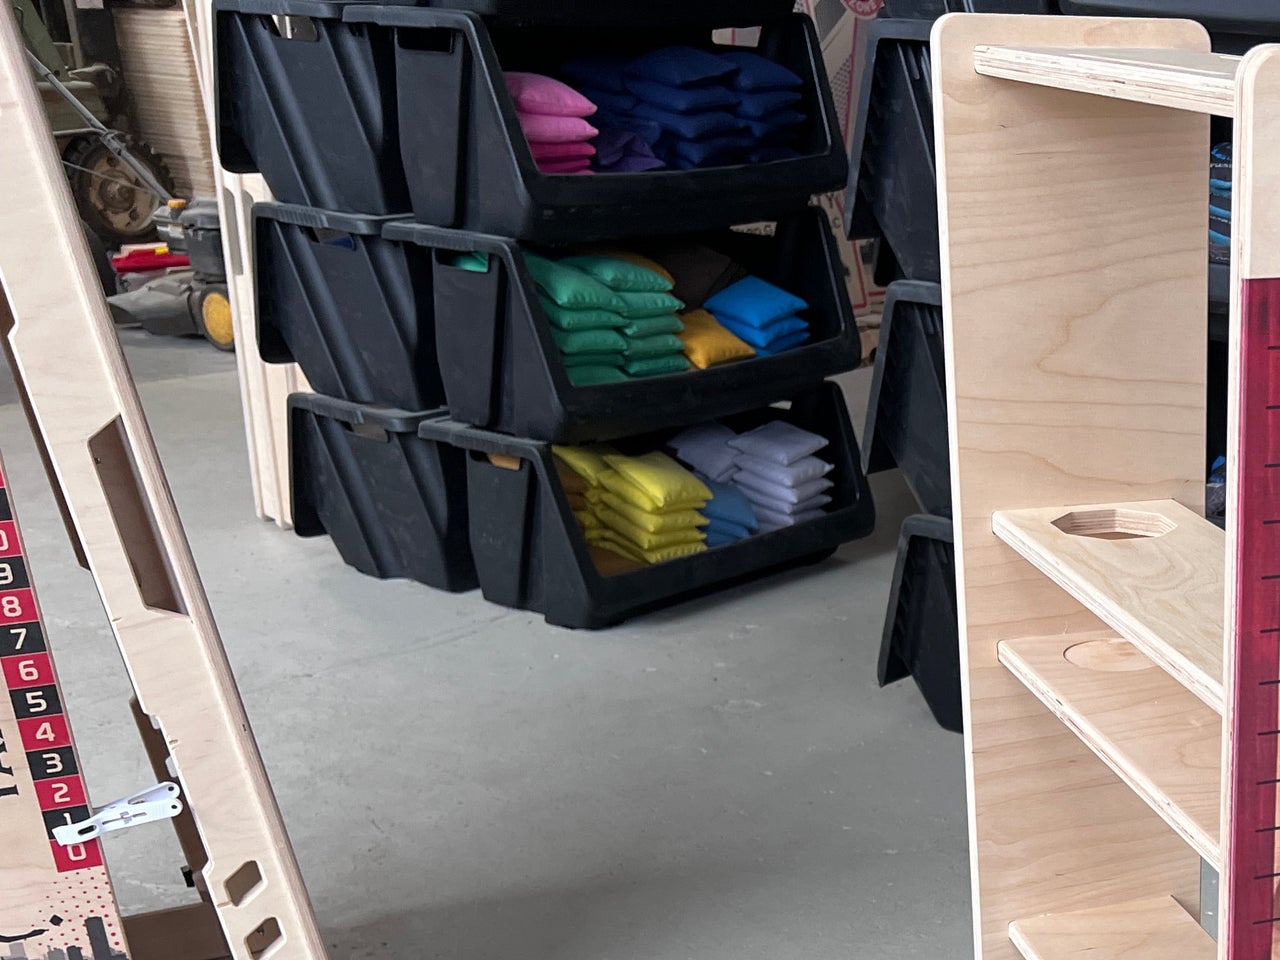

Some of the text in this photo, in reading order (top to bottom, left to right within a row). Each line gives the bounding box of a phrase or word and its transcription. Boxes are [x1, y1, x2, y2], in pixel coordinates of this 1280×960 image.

[2, 596, 22, 617] 8
[9, 629, 27, 650] 7
[18, 660, 38, 682] 6
[25, 692, 47, 712] 5
[35, 722, 55, 743] 4
[42, 753, 62, 774] 3
[51, 783, 71, 803] 2
[67, 843, 87, 861] 0
